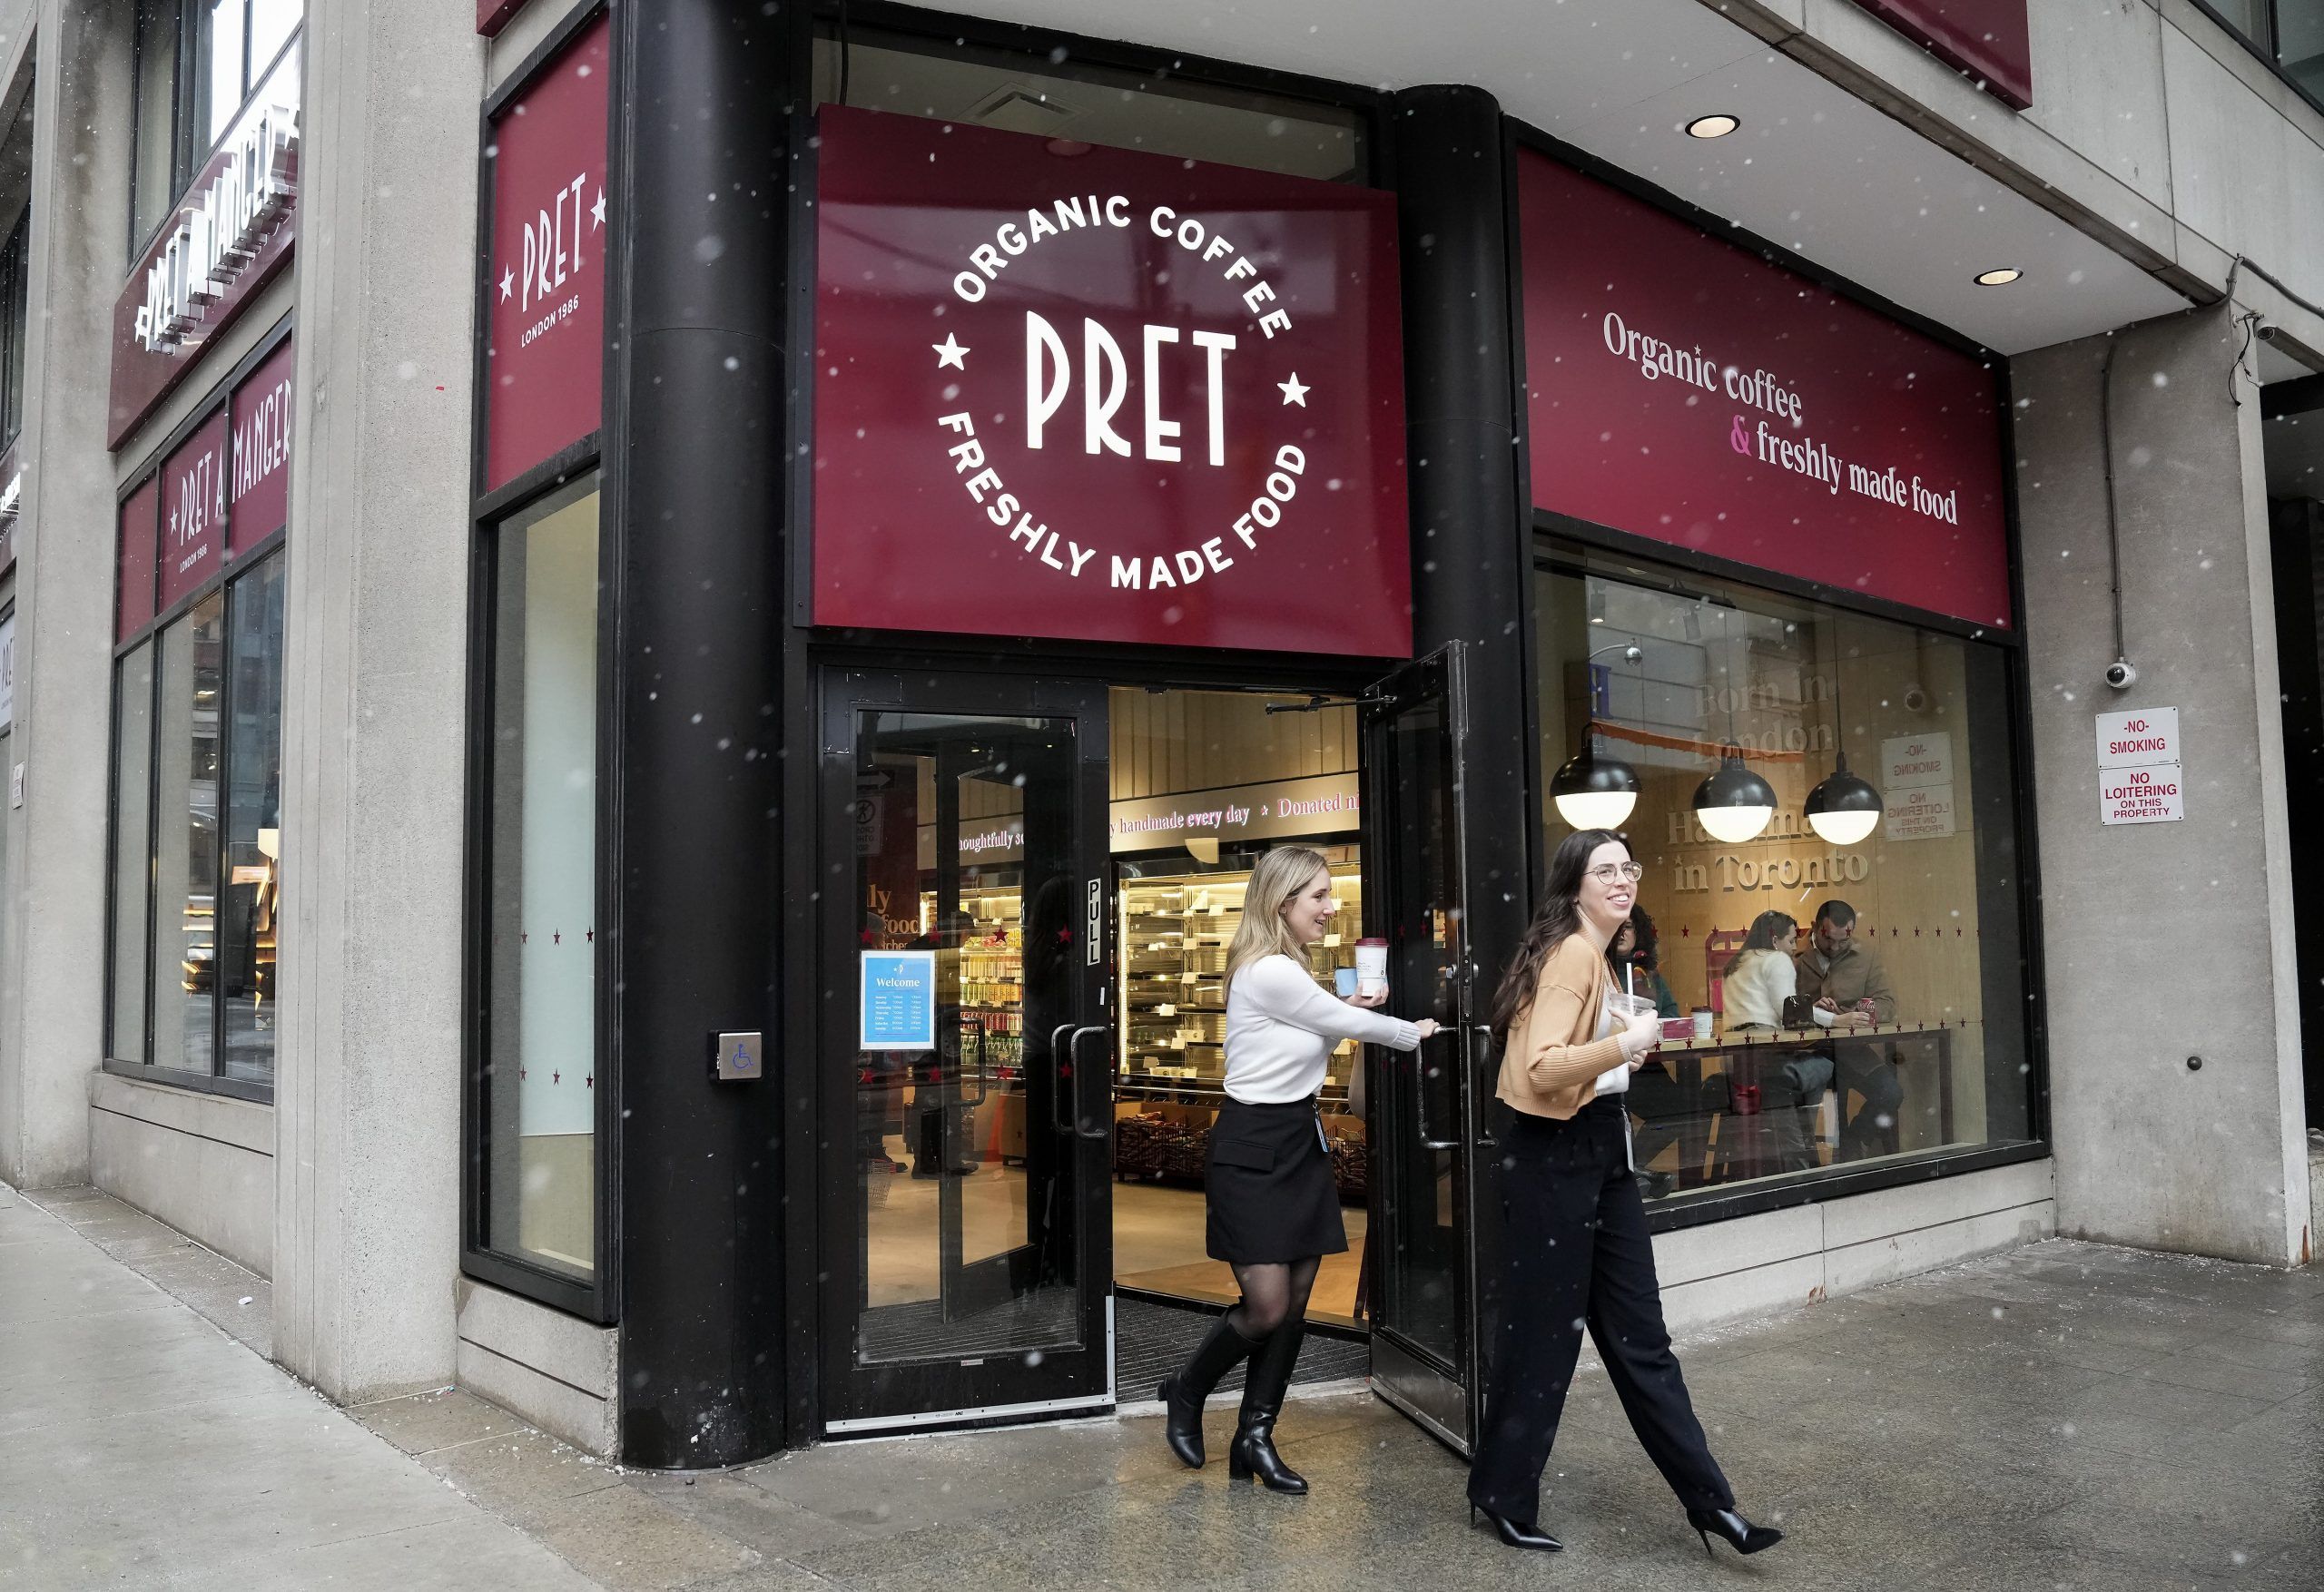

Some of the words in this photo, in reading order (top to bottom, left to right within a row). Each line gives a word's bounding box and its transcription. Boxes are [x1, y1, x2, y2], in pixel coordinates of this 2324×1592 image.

[522, 172, 586, 313] PRET
[953, 195, 1131, 302] ORGANIC
[1150, 206, 1293, 339] COFFEE
[521, 311, 556, 349] LONDON
[558, 294, 579, 321] 1986
[1027, 310, 1236, 467] PRET
[1603, 312, 1718, 392] Organic
[1725, 368, 1802, 423] coffee
[181, 450, 212, 546] PRET
[215, 442, 223, 518] A
[232, 378, 291, 504] MANGER
[1729, 414, 1752, 457] &
[1757, 420, 1843, 496] freshly
[1848, 464, 1907, 507] made
[1911, 476, 1958, 526] food
[938, 412, 1097, 577] FRESHLY
[1111, 536, 1234, 590] MADE
[1232, 445, 1305, 550] FOOD
[180, 551, 197, 573] LONDON
[2110, 737, 2166, 754] SMOKING
[2105, 783, 2177, 800] LOITERING
[2130, 771, 2150, 784] NO
[1119, 811, 1185, 834] handmade
[1187, 810, 1222, 829] every
[1226, 804, 1250, 826] day
[1277, 791, 1342, 818] Donated
[2113, 807, 2170, 819] PROPERTY
[2120, 800, 2135, 809] ON
[2138, 798, 2162, 807] THIS
[1673, 855, 1709, 891] in
[1715, 847, 1868, 891] Toronto
[1089, 881, 1099, 964] PULL
[876, 978, 921, 988] Welcome
